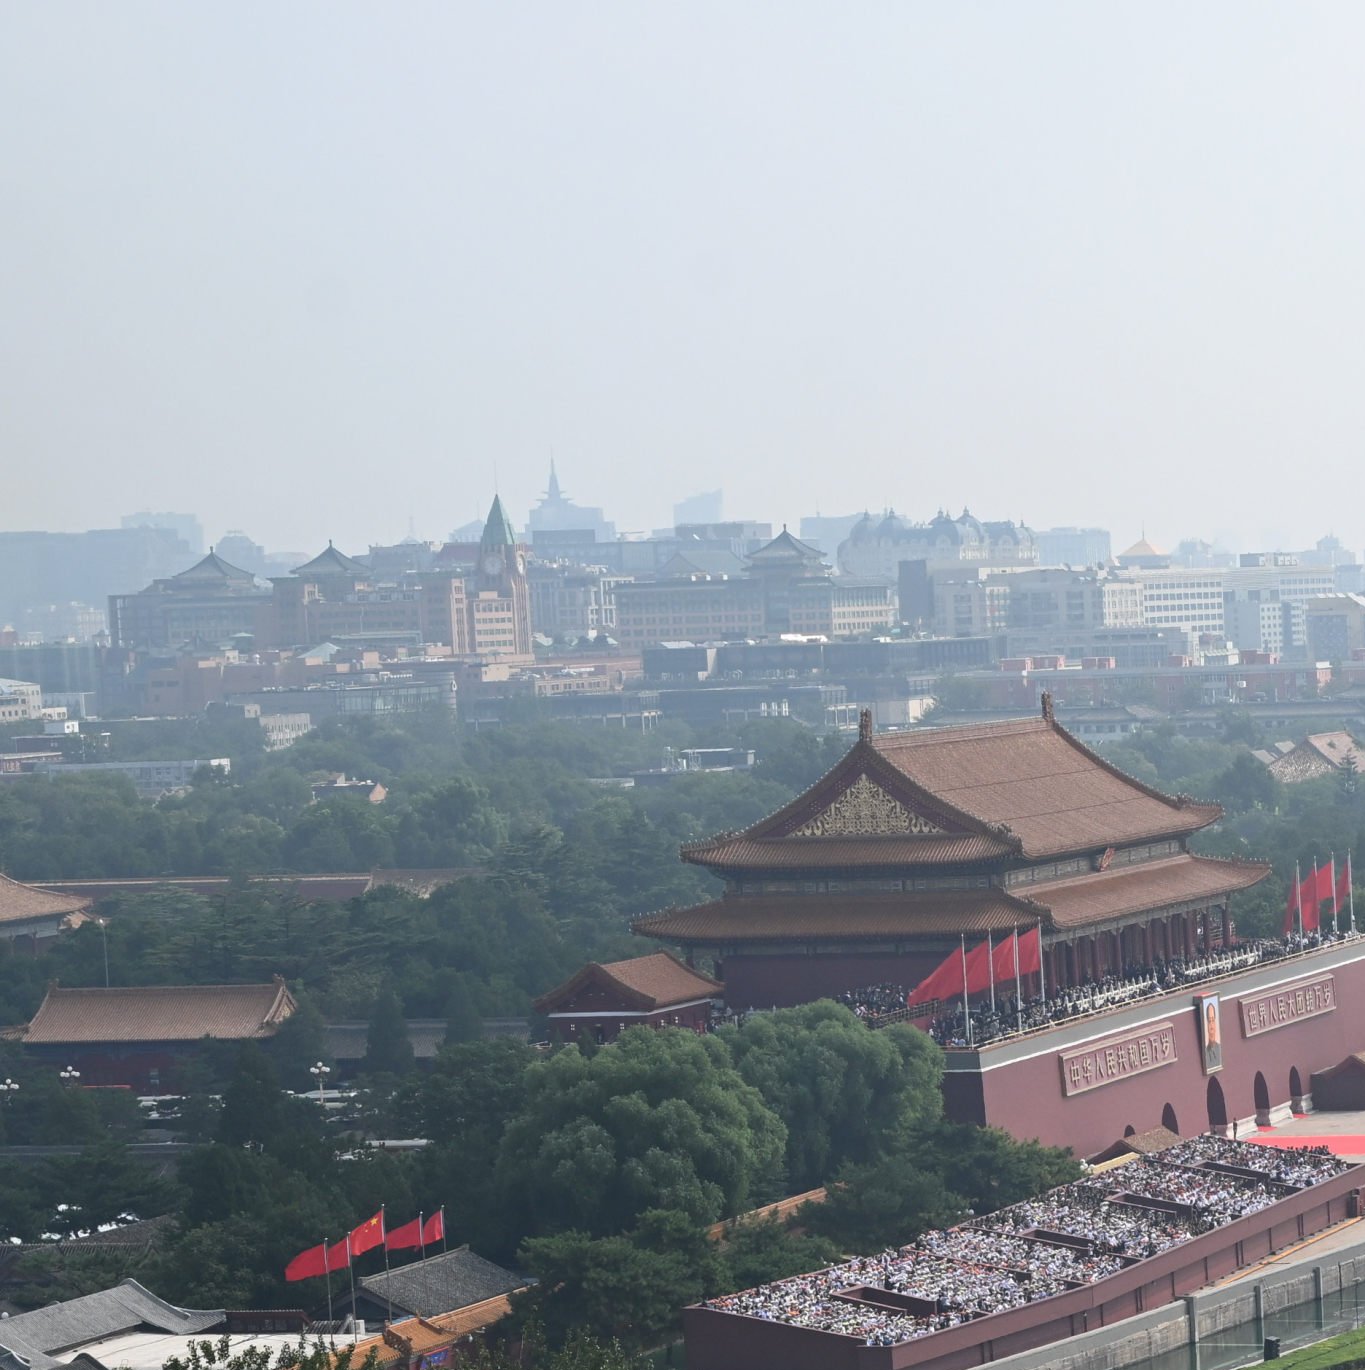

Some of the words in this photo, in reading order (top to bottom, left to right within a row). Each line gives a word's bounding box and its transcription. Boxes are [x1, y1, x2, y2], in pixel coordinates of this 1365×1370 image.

[1248, 983, 1331, 1031] 世界人民大团结万岁
[1070, 1032, 1170, 1087] 中华人民共和国万岁
